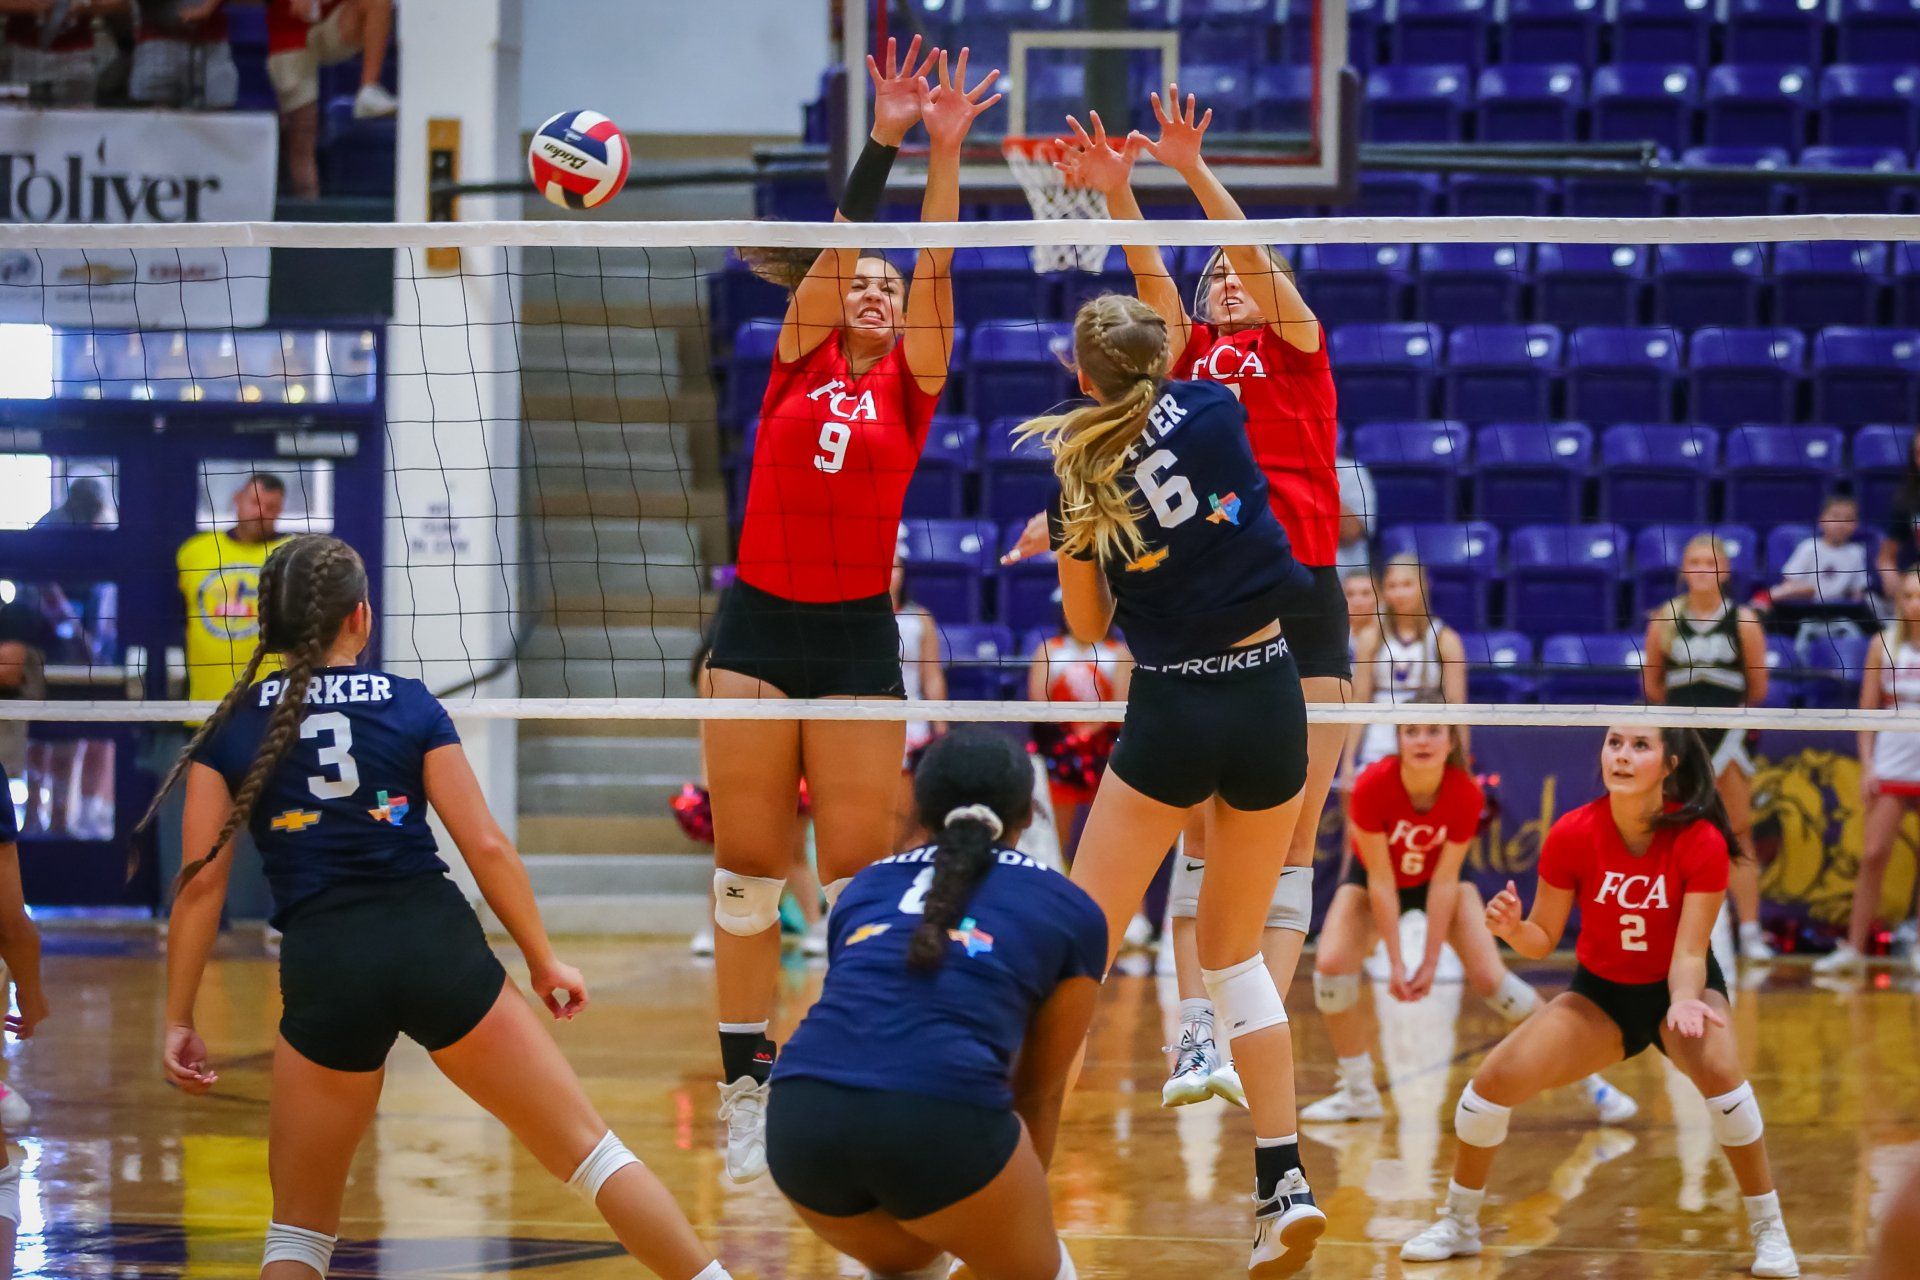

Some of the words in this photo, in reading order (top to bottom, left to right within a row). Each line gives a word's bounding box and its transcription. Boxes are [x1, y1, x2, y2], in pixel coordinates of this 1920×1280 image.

[0, 138, 222, 222] Toliver
[813, 421, 852, 474] 9
[1134, 449, 1199, 529] 6
[300, 711, 360, 800] 3
[1593, 871, 1669, 909] FCA
[1619, 914, 1648, 952] 2
